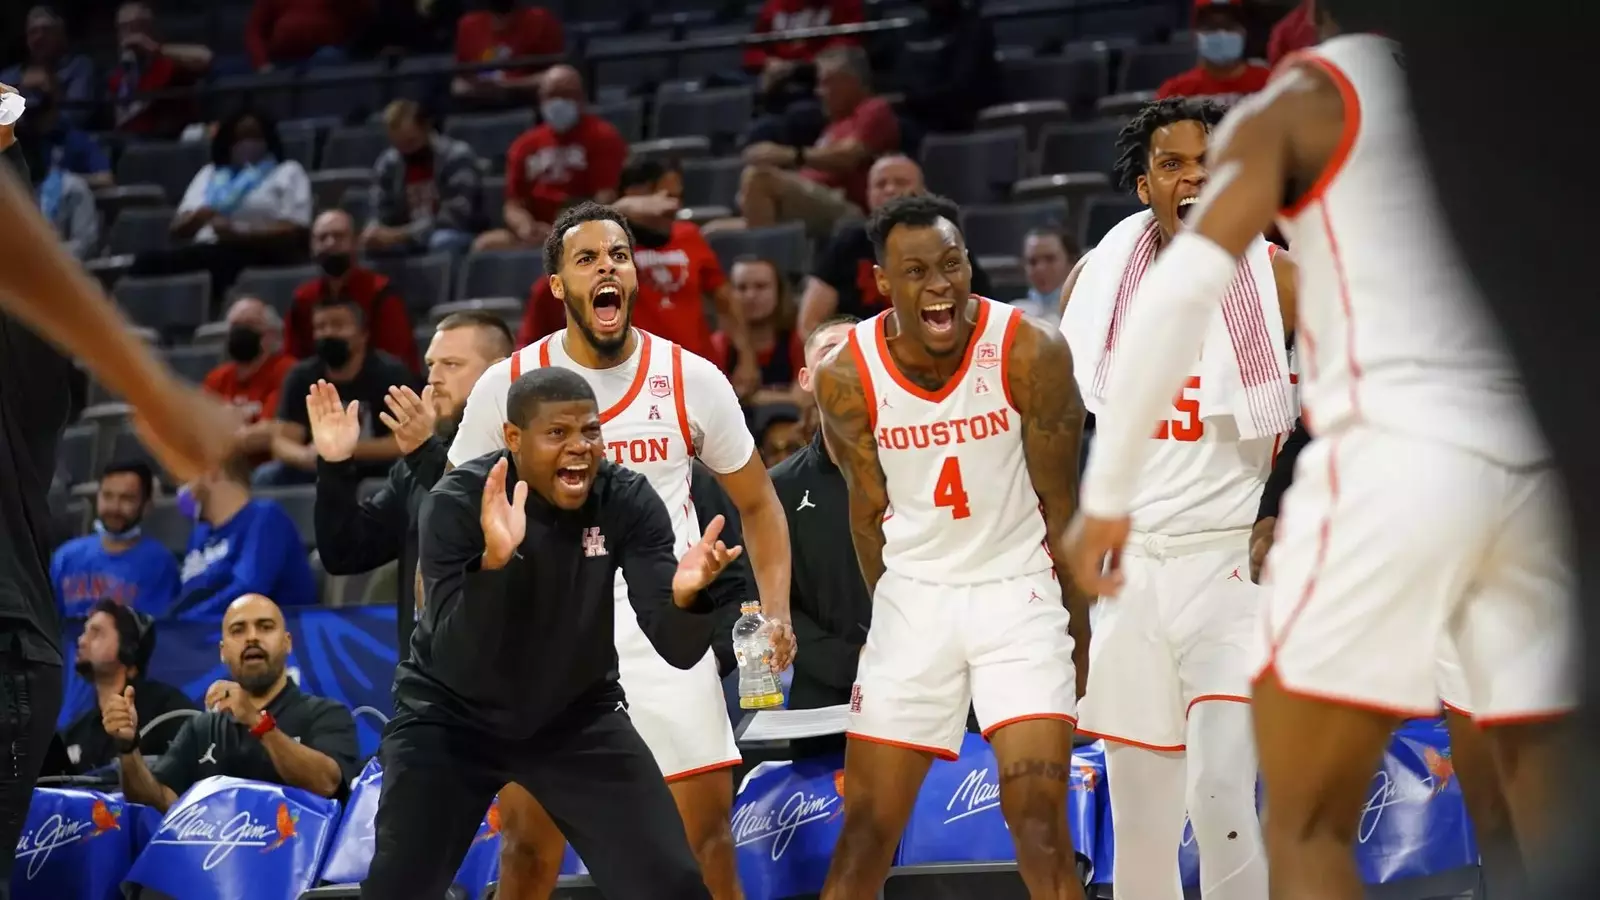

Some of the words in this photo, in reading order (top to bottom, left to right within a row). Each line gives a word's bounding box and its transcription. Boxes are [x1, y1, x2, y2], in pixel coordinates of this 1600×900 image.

[980, 348, 995, 358] 75
[652, 380, 667, 389] 75
[601, 437, 669, 464] TON
[878, 407, 1010, 450] HOUSTON
[933, 456, 971, 520] 4
[946, 767, 1001, 811] Mau
[27, 813, 92, 880] Jim
[159, 803, 221, 841] Maui
[202, 811, 276, 871] Jim
[731, 800, 776, 843] Maui
[771, 791, 838, 861] Jim
